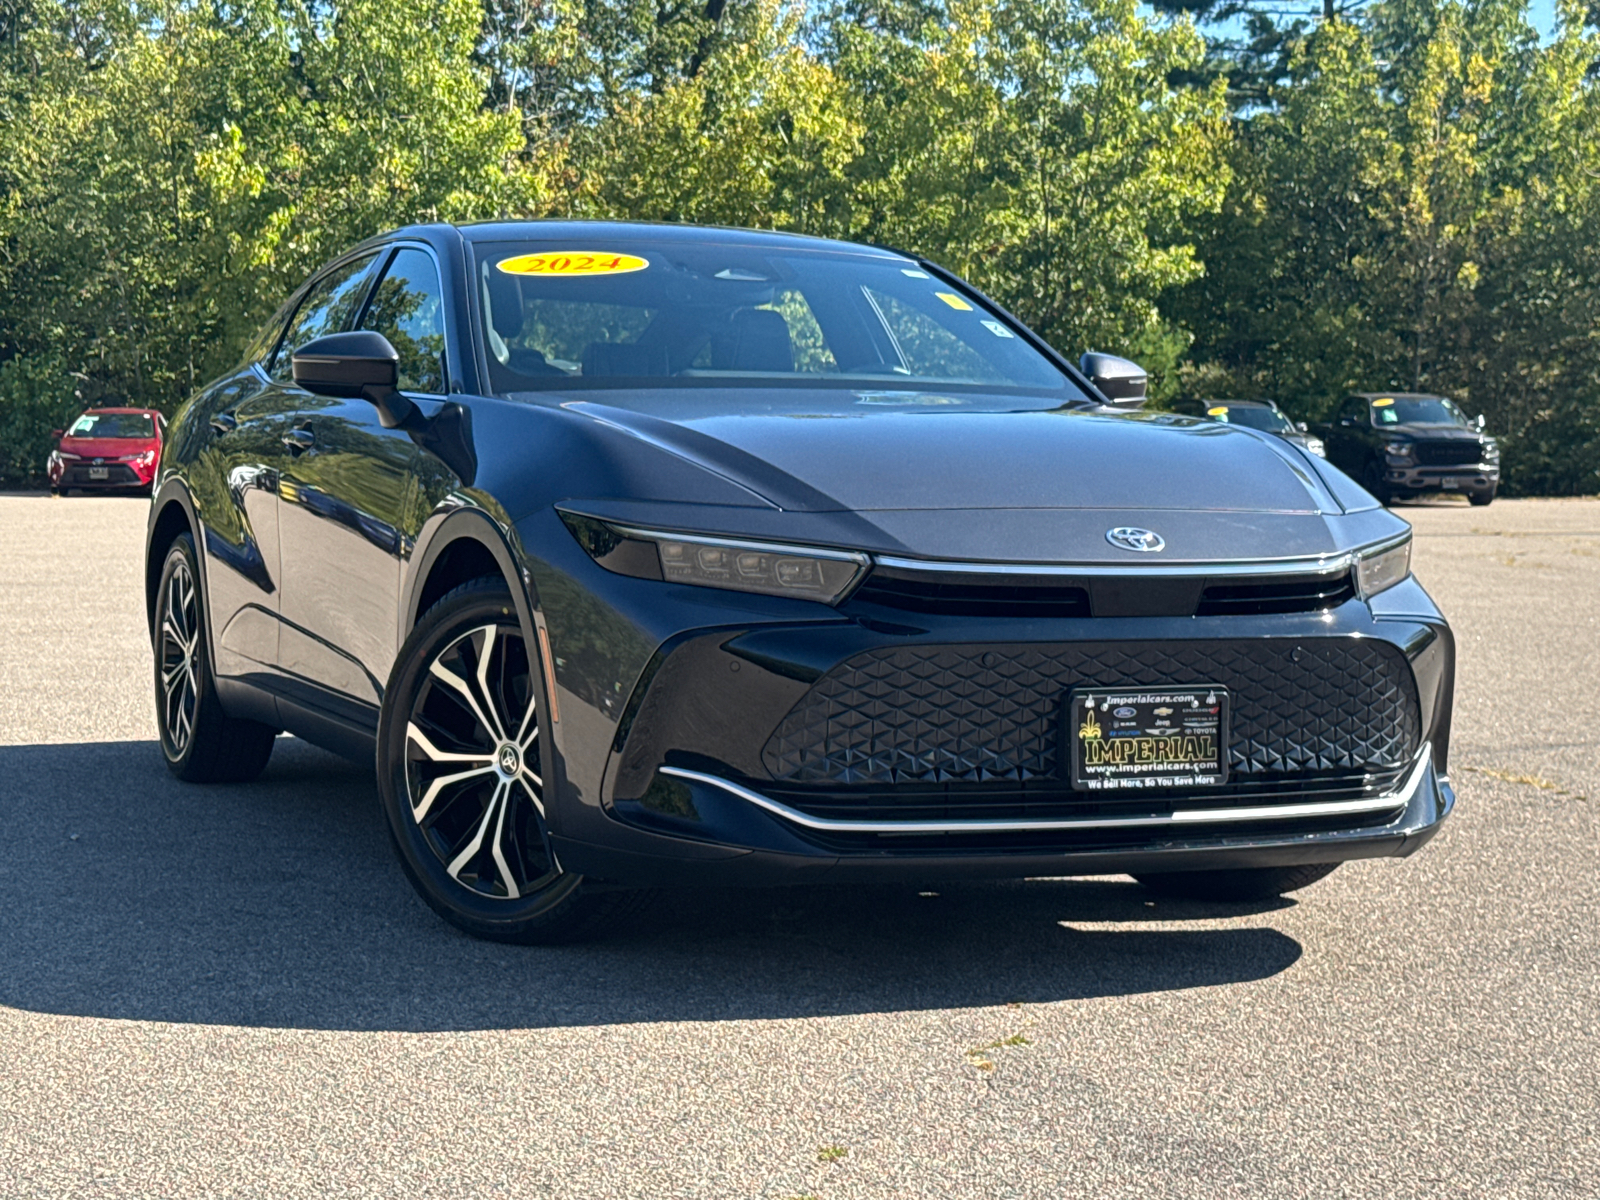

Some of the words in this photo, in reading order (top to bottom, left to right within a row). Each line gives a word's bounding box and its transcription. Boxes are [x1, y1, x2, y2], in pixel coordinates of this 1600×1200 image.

[525, 257, 621, 272] 2024
[1193, 727, 1217, 735] TOYOTA
[1085, 736, 1218, 765] IMPERIAL
[1085, 762, 1218, 774] www.imperialcars.com
[1087, 780, 1101, 790] We
[1103, 780, 1118, 789] Sell
[1144, 778, 1156, 787] So
[1157, 777, 1172, 787] You
[1174, 776, 1193, 786] Save
[1195, 774, 1215, 785] More
